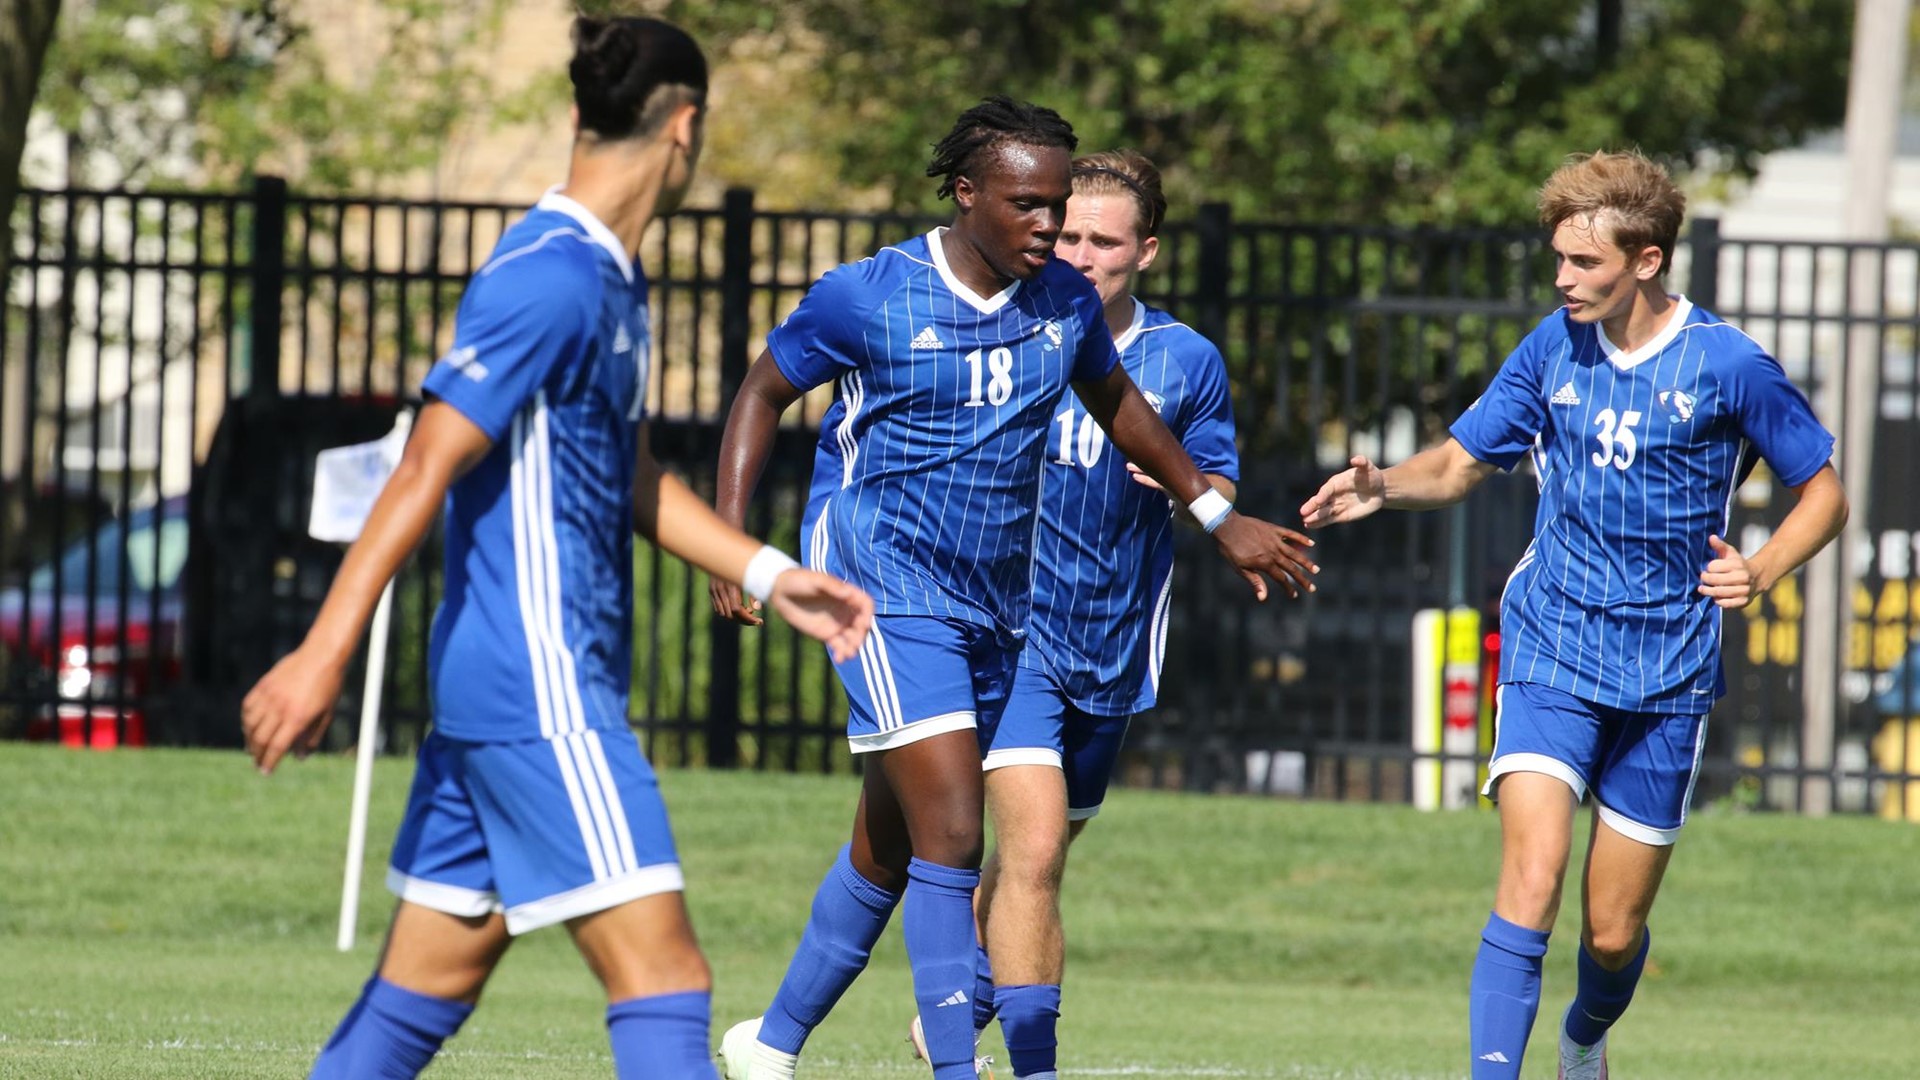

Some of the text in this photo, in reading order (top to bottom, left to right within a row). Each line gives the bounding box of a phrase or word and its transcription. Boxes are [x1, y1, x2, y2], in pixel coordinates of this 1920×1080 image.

[911, 341, 944, 349] adidas
[964, 347, 1013, 407] 18
[1551, 396, 1580, 405] adidas
[1054, 408, 1105, 468] 10
[1592, 408, 1642, 470] 35
